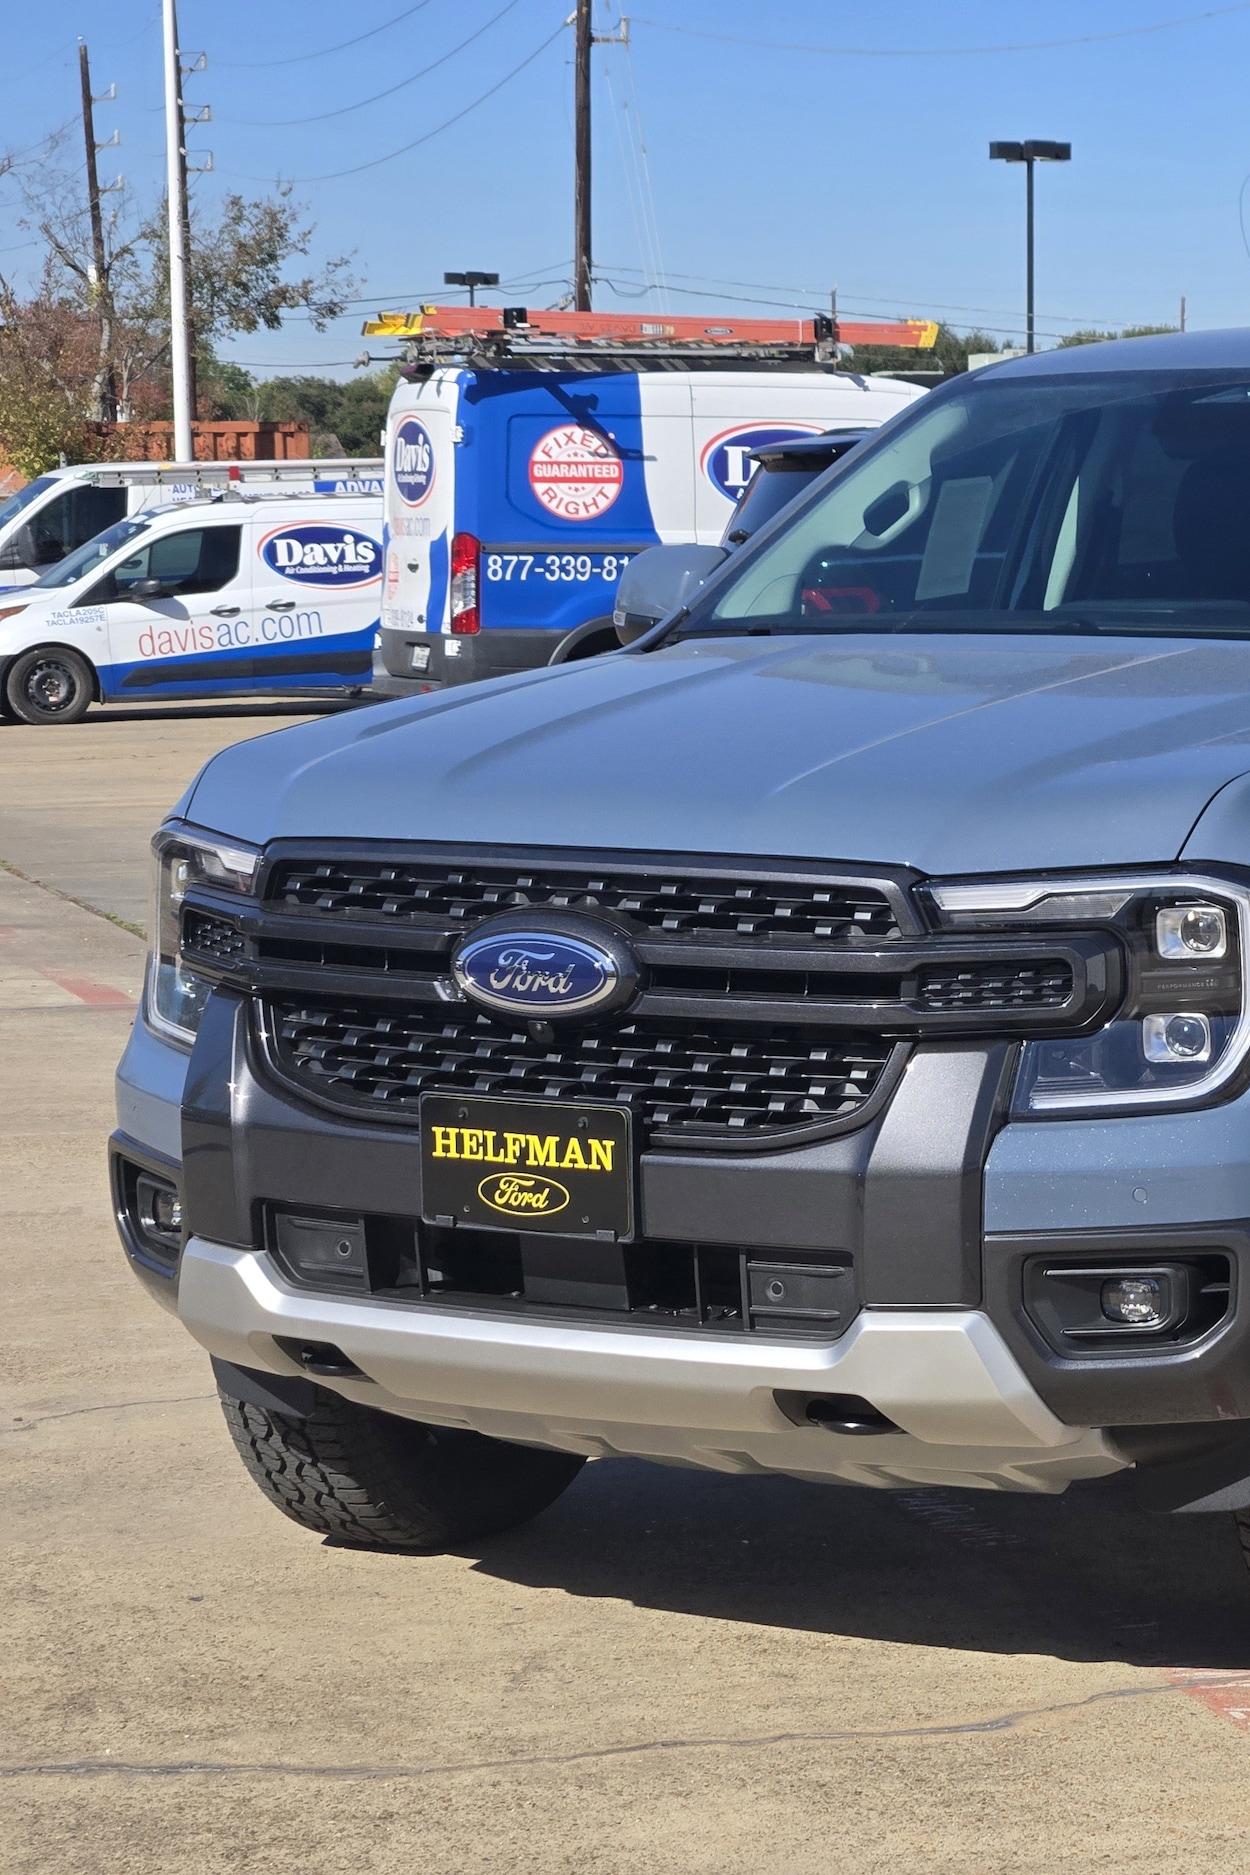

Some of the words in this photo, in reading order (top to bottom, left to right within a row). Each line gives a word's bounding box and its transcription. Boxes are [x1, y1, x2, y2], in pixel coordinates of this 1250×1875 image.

[395, 433, 430, 472] Davis
[541, 431, 609, 459] FIXED
[335, 480, 385, 493] ADVA
[533, 463, 620, 479] GUARANTEED
[541, 486, 610, 515] RIGHT
[273, 534, 376, 567] Davis
[138, 610, 324, 658] davisac.com
[489, 948, 576, 994] Ford
[431, 1126, 616, 1172] HELFMAN
[494, 1177, 550, 1209] Ford
